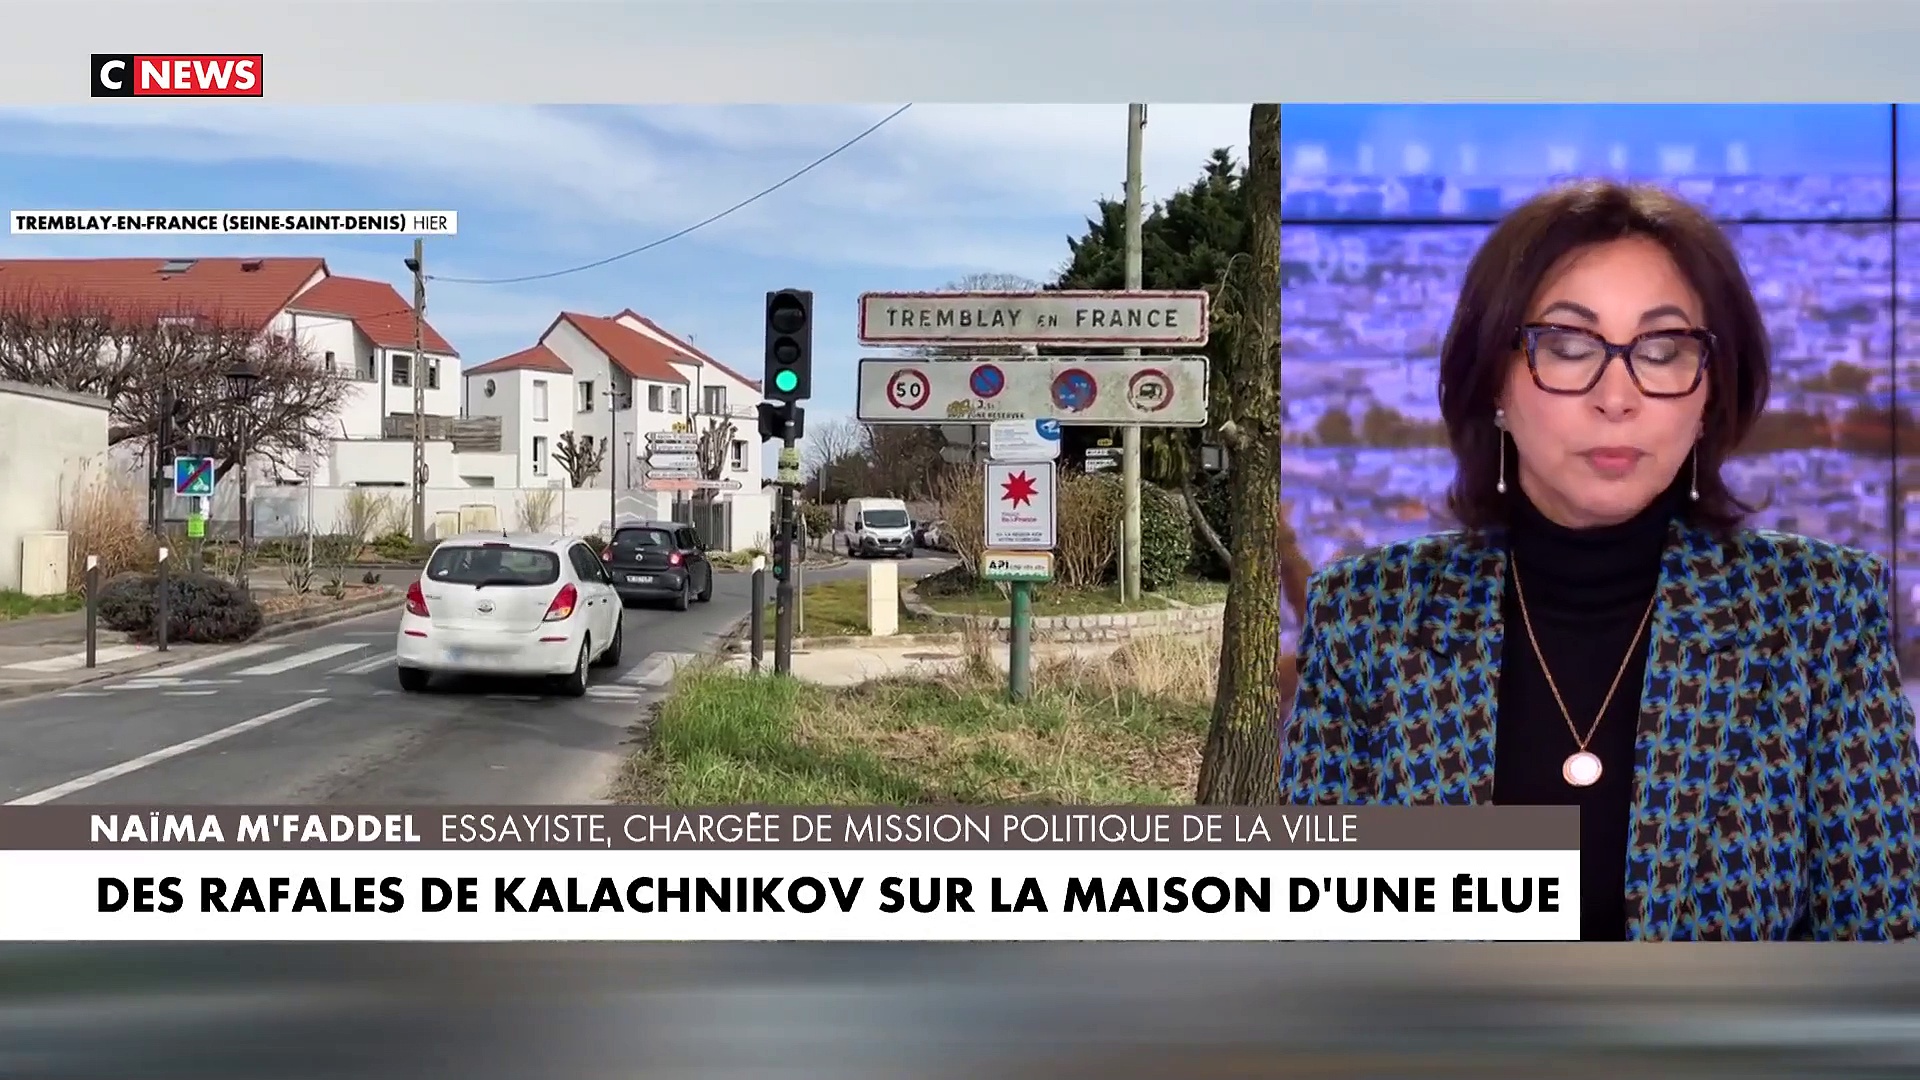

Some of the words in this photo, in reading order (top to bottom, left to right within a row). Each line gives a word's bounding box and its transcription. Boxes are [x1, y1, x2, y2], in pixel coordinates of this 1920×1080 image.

[886, 309, 1022, 327] TREMBLAY
[1037, 315, 1058, 327] EN
[1075, 309, 1179, 327] FRANCE
[896, 381, 921, 397] 50
[989, 560, 1009, 569] API
